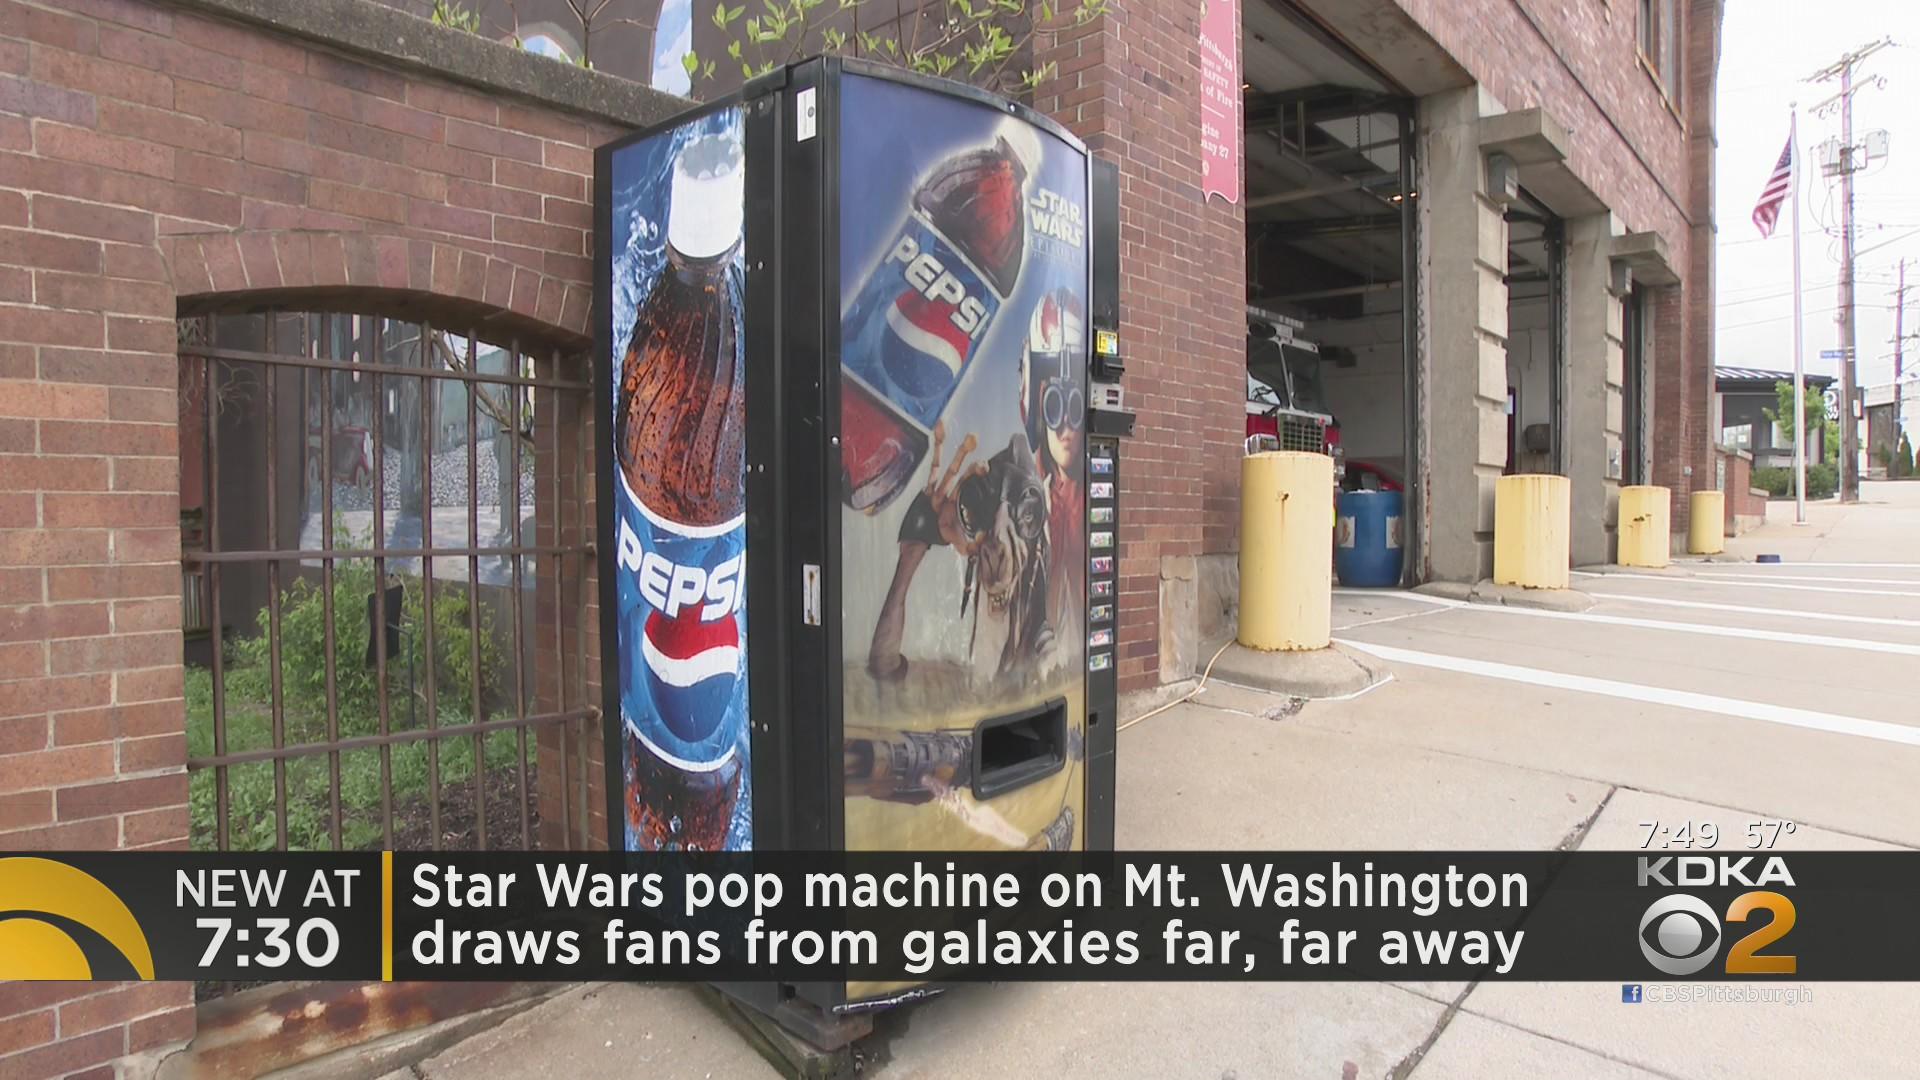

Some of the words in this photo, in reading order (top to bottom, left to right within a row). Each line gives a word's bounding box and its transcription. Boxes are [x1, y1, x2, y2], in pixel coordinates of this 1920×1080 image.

[1217, 89, 1233, 108] Fire
[1030, 187, 1081, 226] STAR
[1031, 207, 1084, 248] WARS
[885, 234, 991, 340] PEPSI
